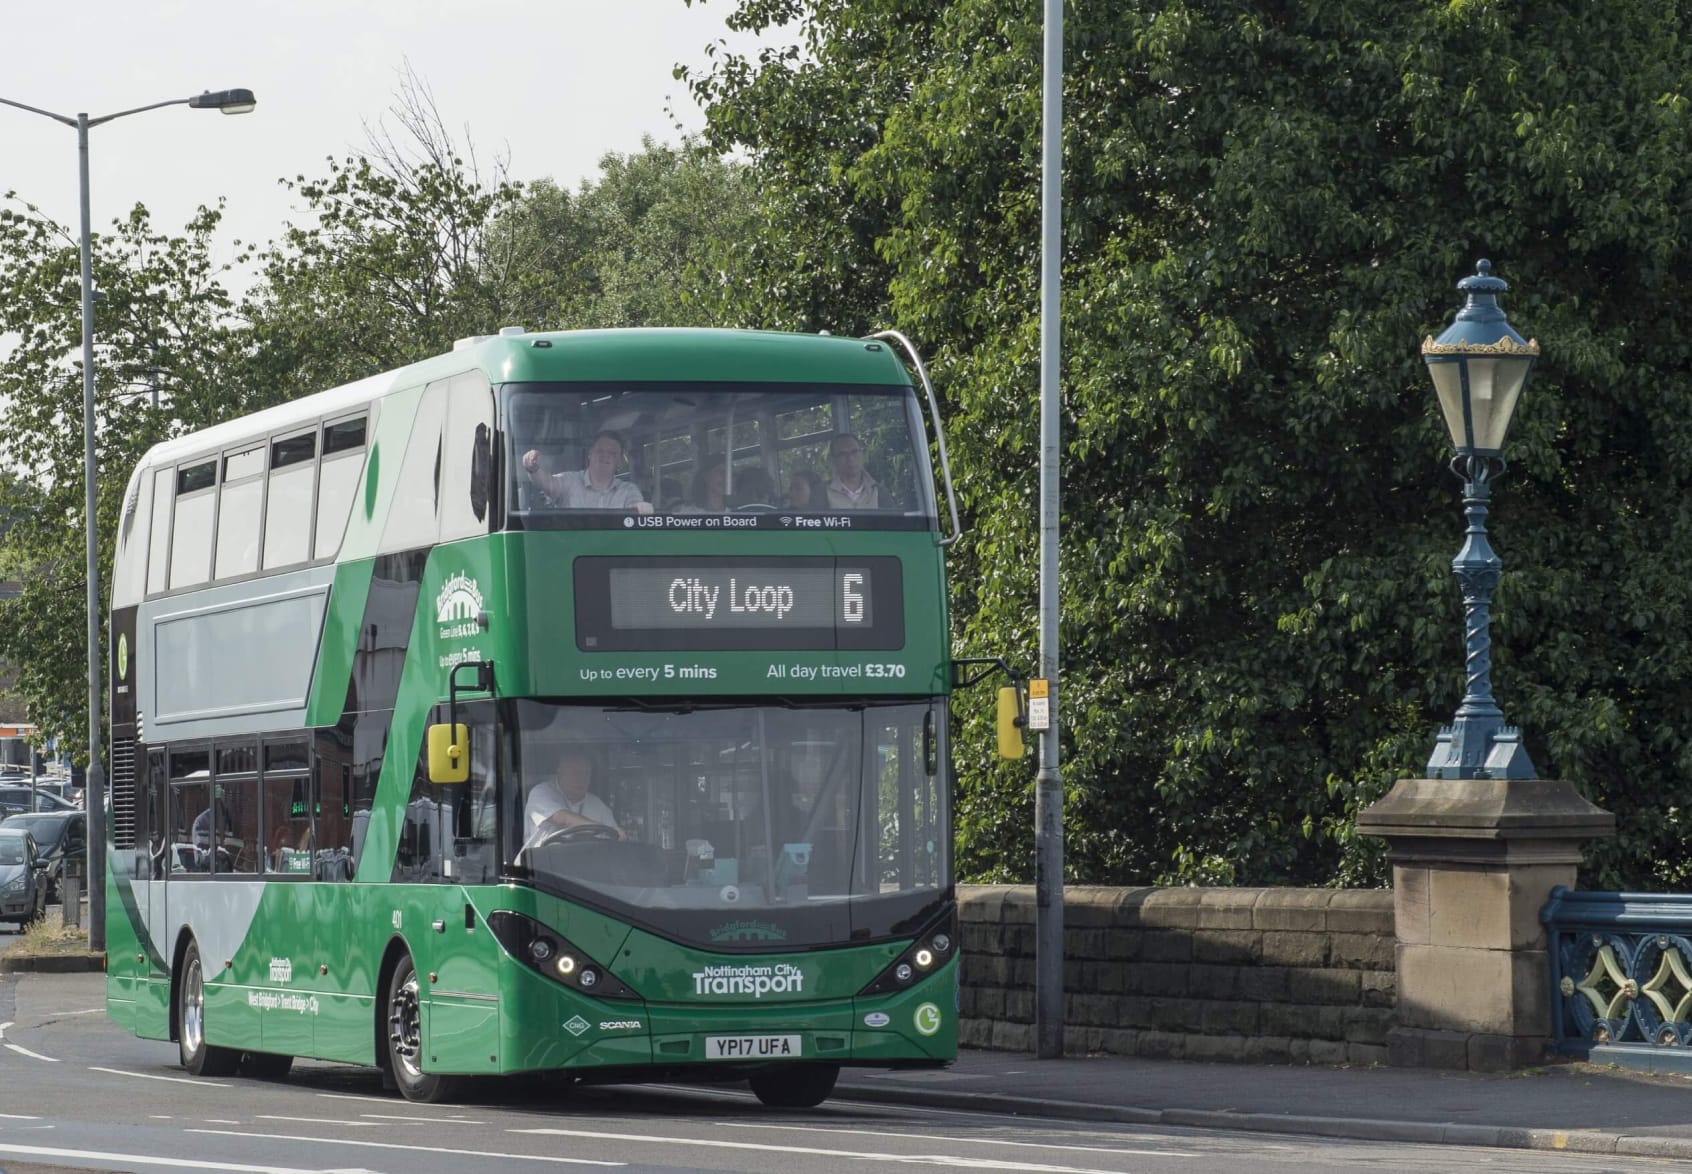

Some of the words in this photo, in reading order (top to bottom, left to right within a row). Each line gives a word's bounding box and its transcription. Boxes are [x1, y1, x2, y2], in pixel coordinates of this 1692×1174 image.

[637, 516, 663, 528] USB
[666, 516, 703, 527] Power
[706, 519, 720, 527] on
[723, 516, 757, 527] Board
[795, 516, 821, 528] Free
[824, 517, 851, 527] Wi-Fi
[668, 578, 720, 619] City
[730, 578, 794, 619] Loop
[843, 573, 864, 622] 6
[580, 668, 598, 682] Up
[601, 669, 613, 679] to
[616, 667, 660, 683] every
[664, 665, 675, 679] 5
[679, 664, 717, 679] mins
[767, 665, 786, 678] All
[790, 665, 817, 682] day
[821, 664, 862, 678] travel
[865, 664, 905, 678] £3.70
[704, 965, 772, 980] Nottingham
[774, 964, 798, 978] City
[692, 969, 804, 998] Transport
[600, 1021, 641, 1030] SCANIA
[717, 1039, 753, 1056] YP17
[758, 1038, 791, 1055] UFA
